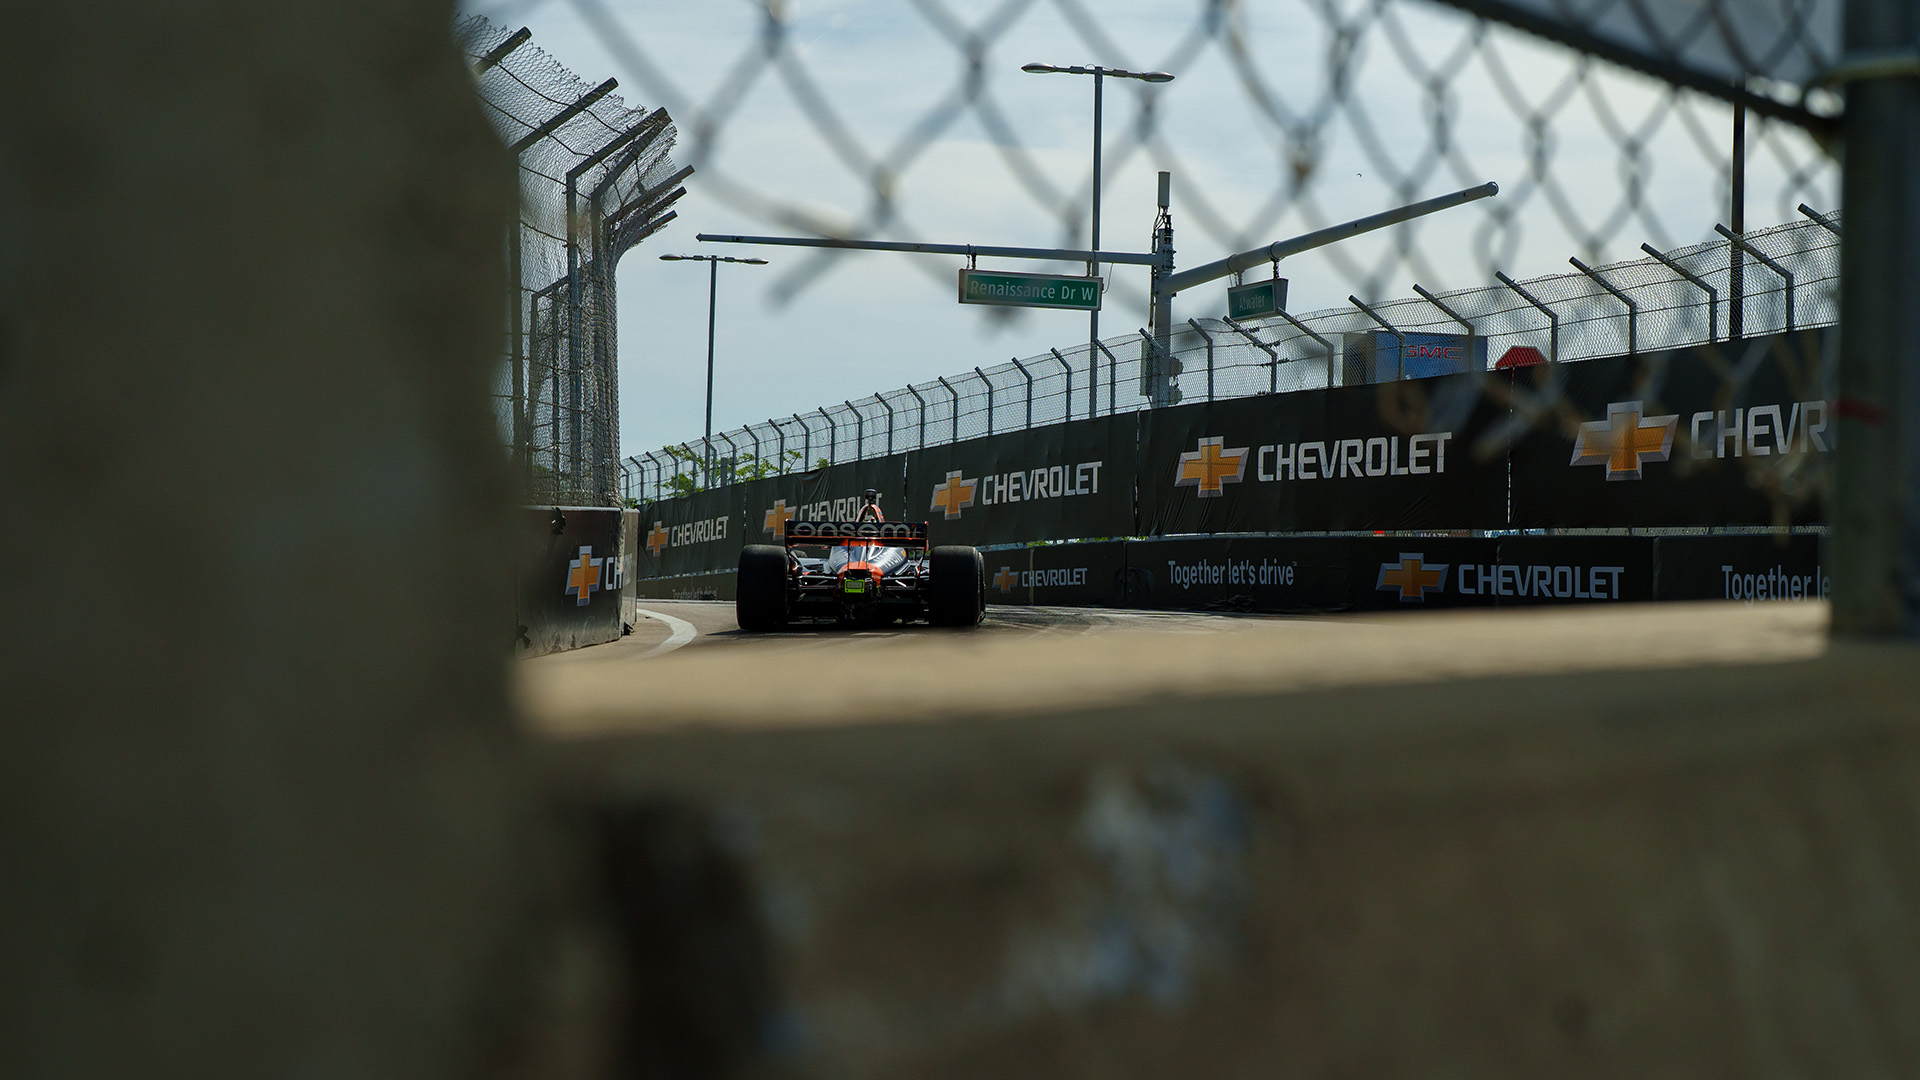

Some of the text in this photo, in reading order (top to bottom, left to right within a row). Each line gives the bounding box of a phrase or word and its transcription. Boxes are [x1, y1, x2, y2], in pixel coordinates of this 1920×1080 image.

[971, 281, 1094, 301] Renaissance Dr W
[1239, 294, 1265, 311] Atwater
[1690, 400, 1836, 460] CHEVR
[1257, 432, 1452, 482] CHEVROLET
[982, 461, 1103, 506] CHEVROLET
[671, 515, 729, 548] CHEVROLET
[1021, 567, 1088, 588] CHEVROLET
[1168, 558, 1294, 590] Together let's drive
[1457, 564, 1625, 600] CHEVROLET
[1721, 564, 1812, 606] Together
